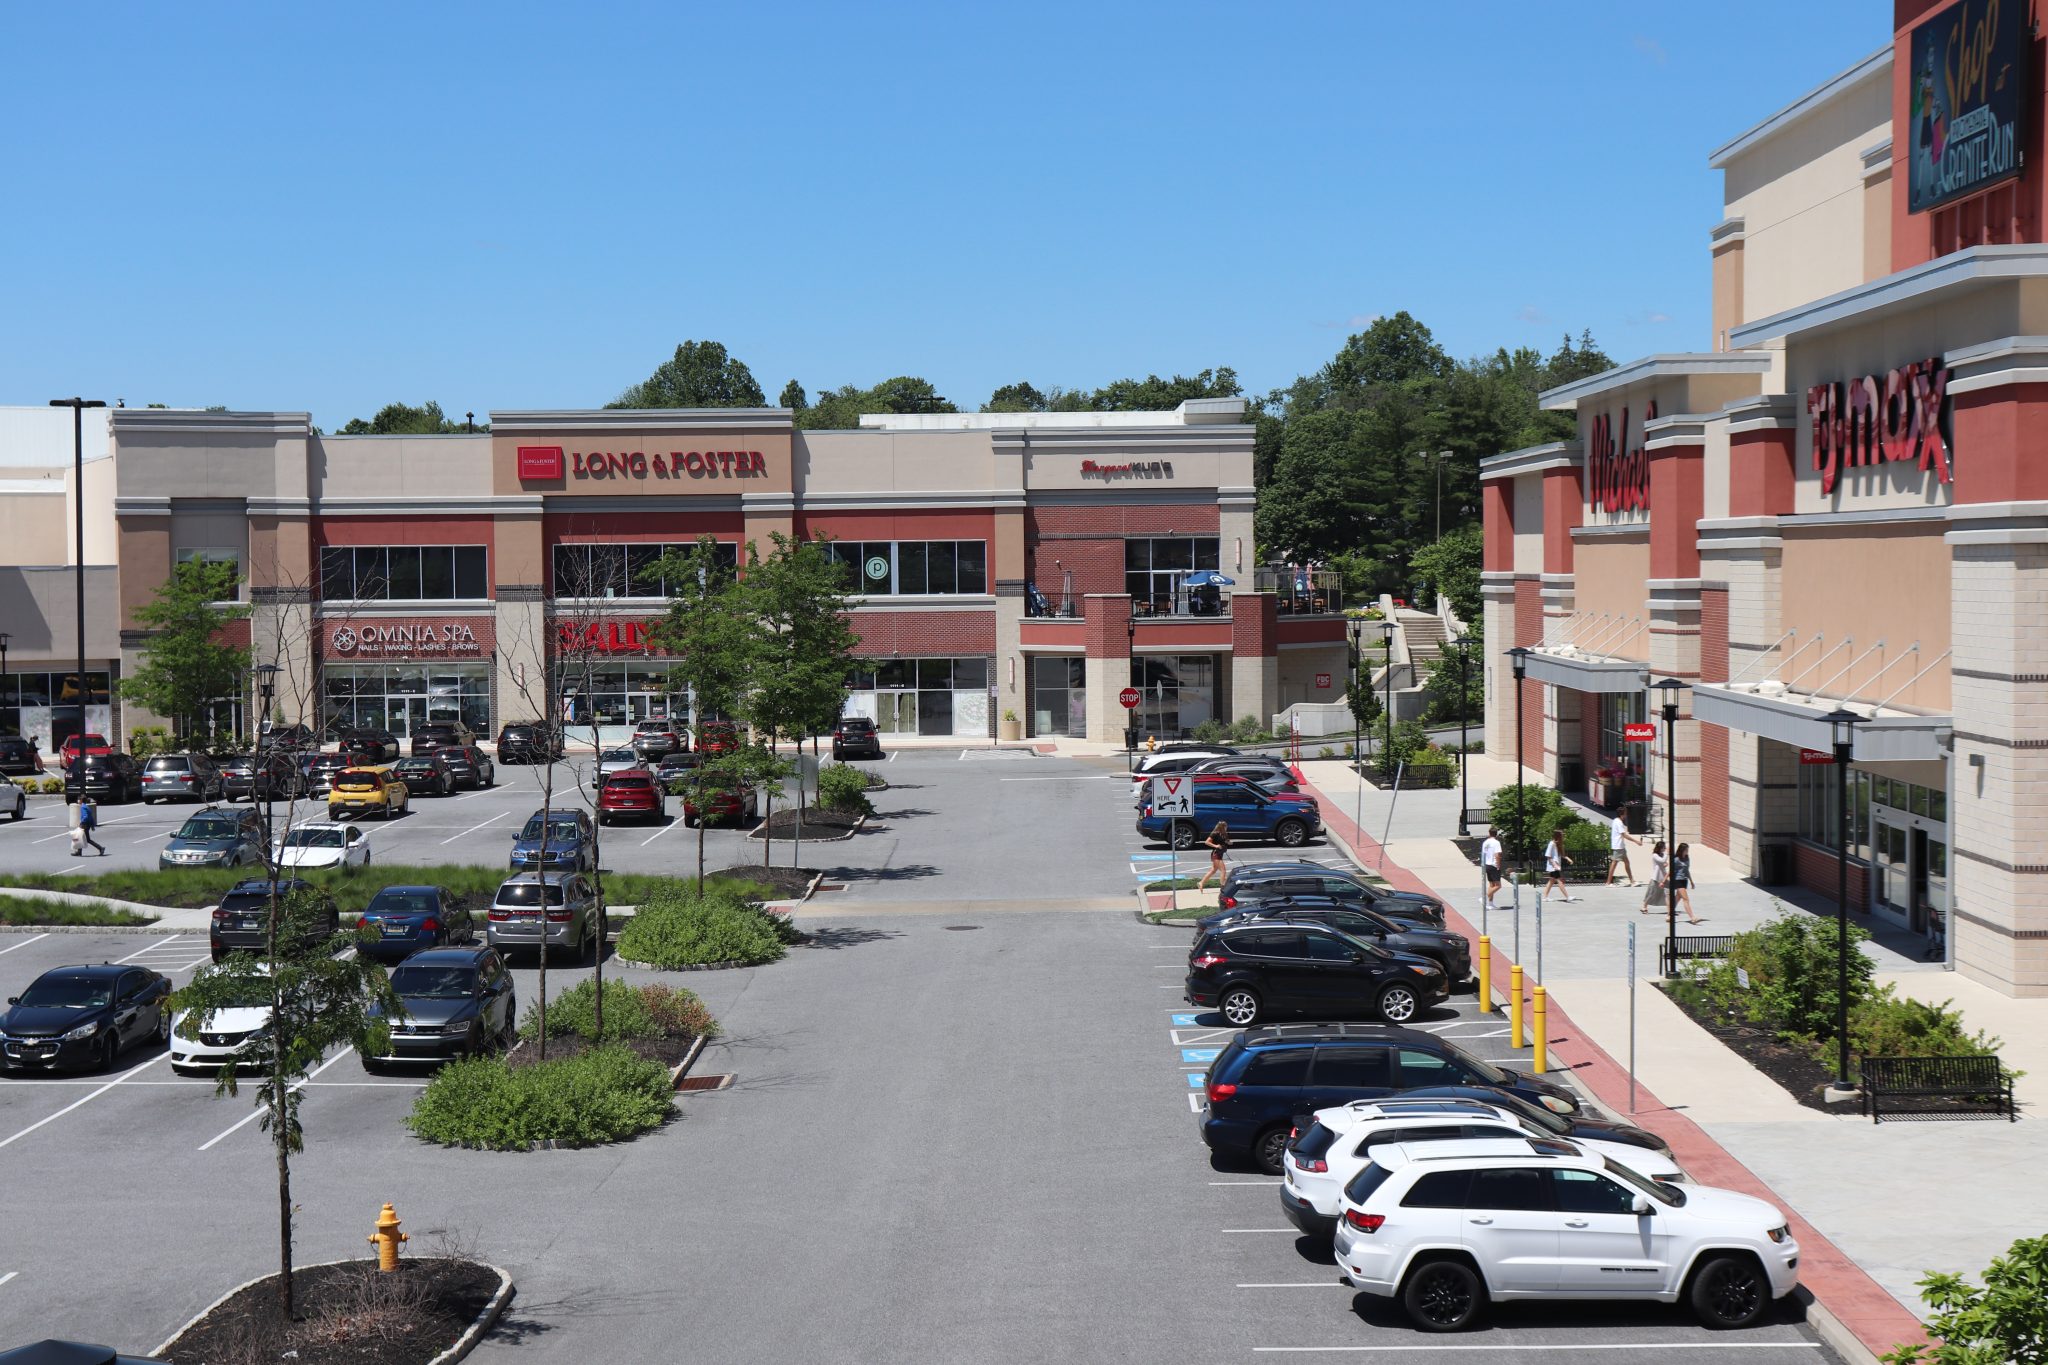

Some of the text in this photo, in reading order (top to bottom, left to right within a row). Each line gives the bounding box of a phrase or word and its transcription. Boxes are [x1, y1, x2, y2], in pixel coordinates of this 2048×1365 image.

[573, 452, 764, 473] LONG & FOSTER
[361, 625, 475, 642] OMNIA SPA
[1120, 694, 1139, 702] STOP
